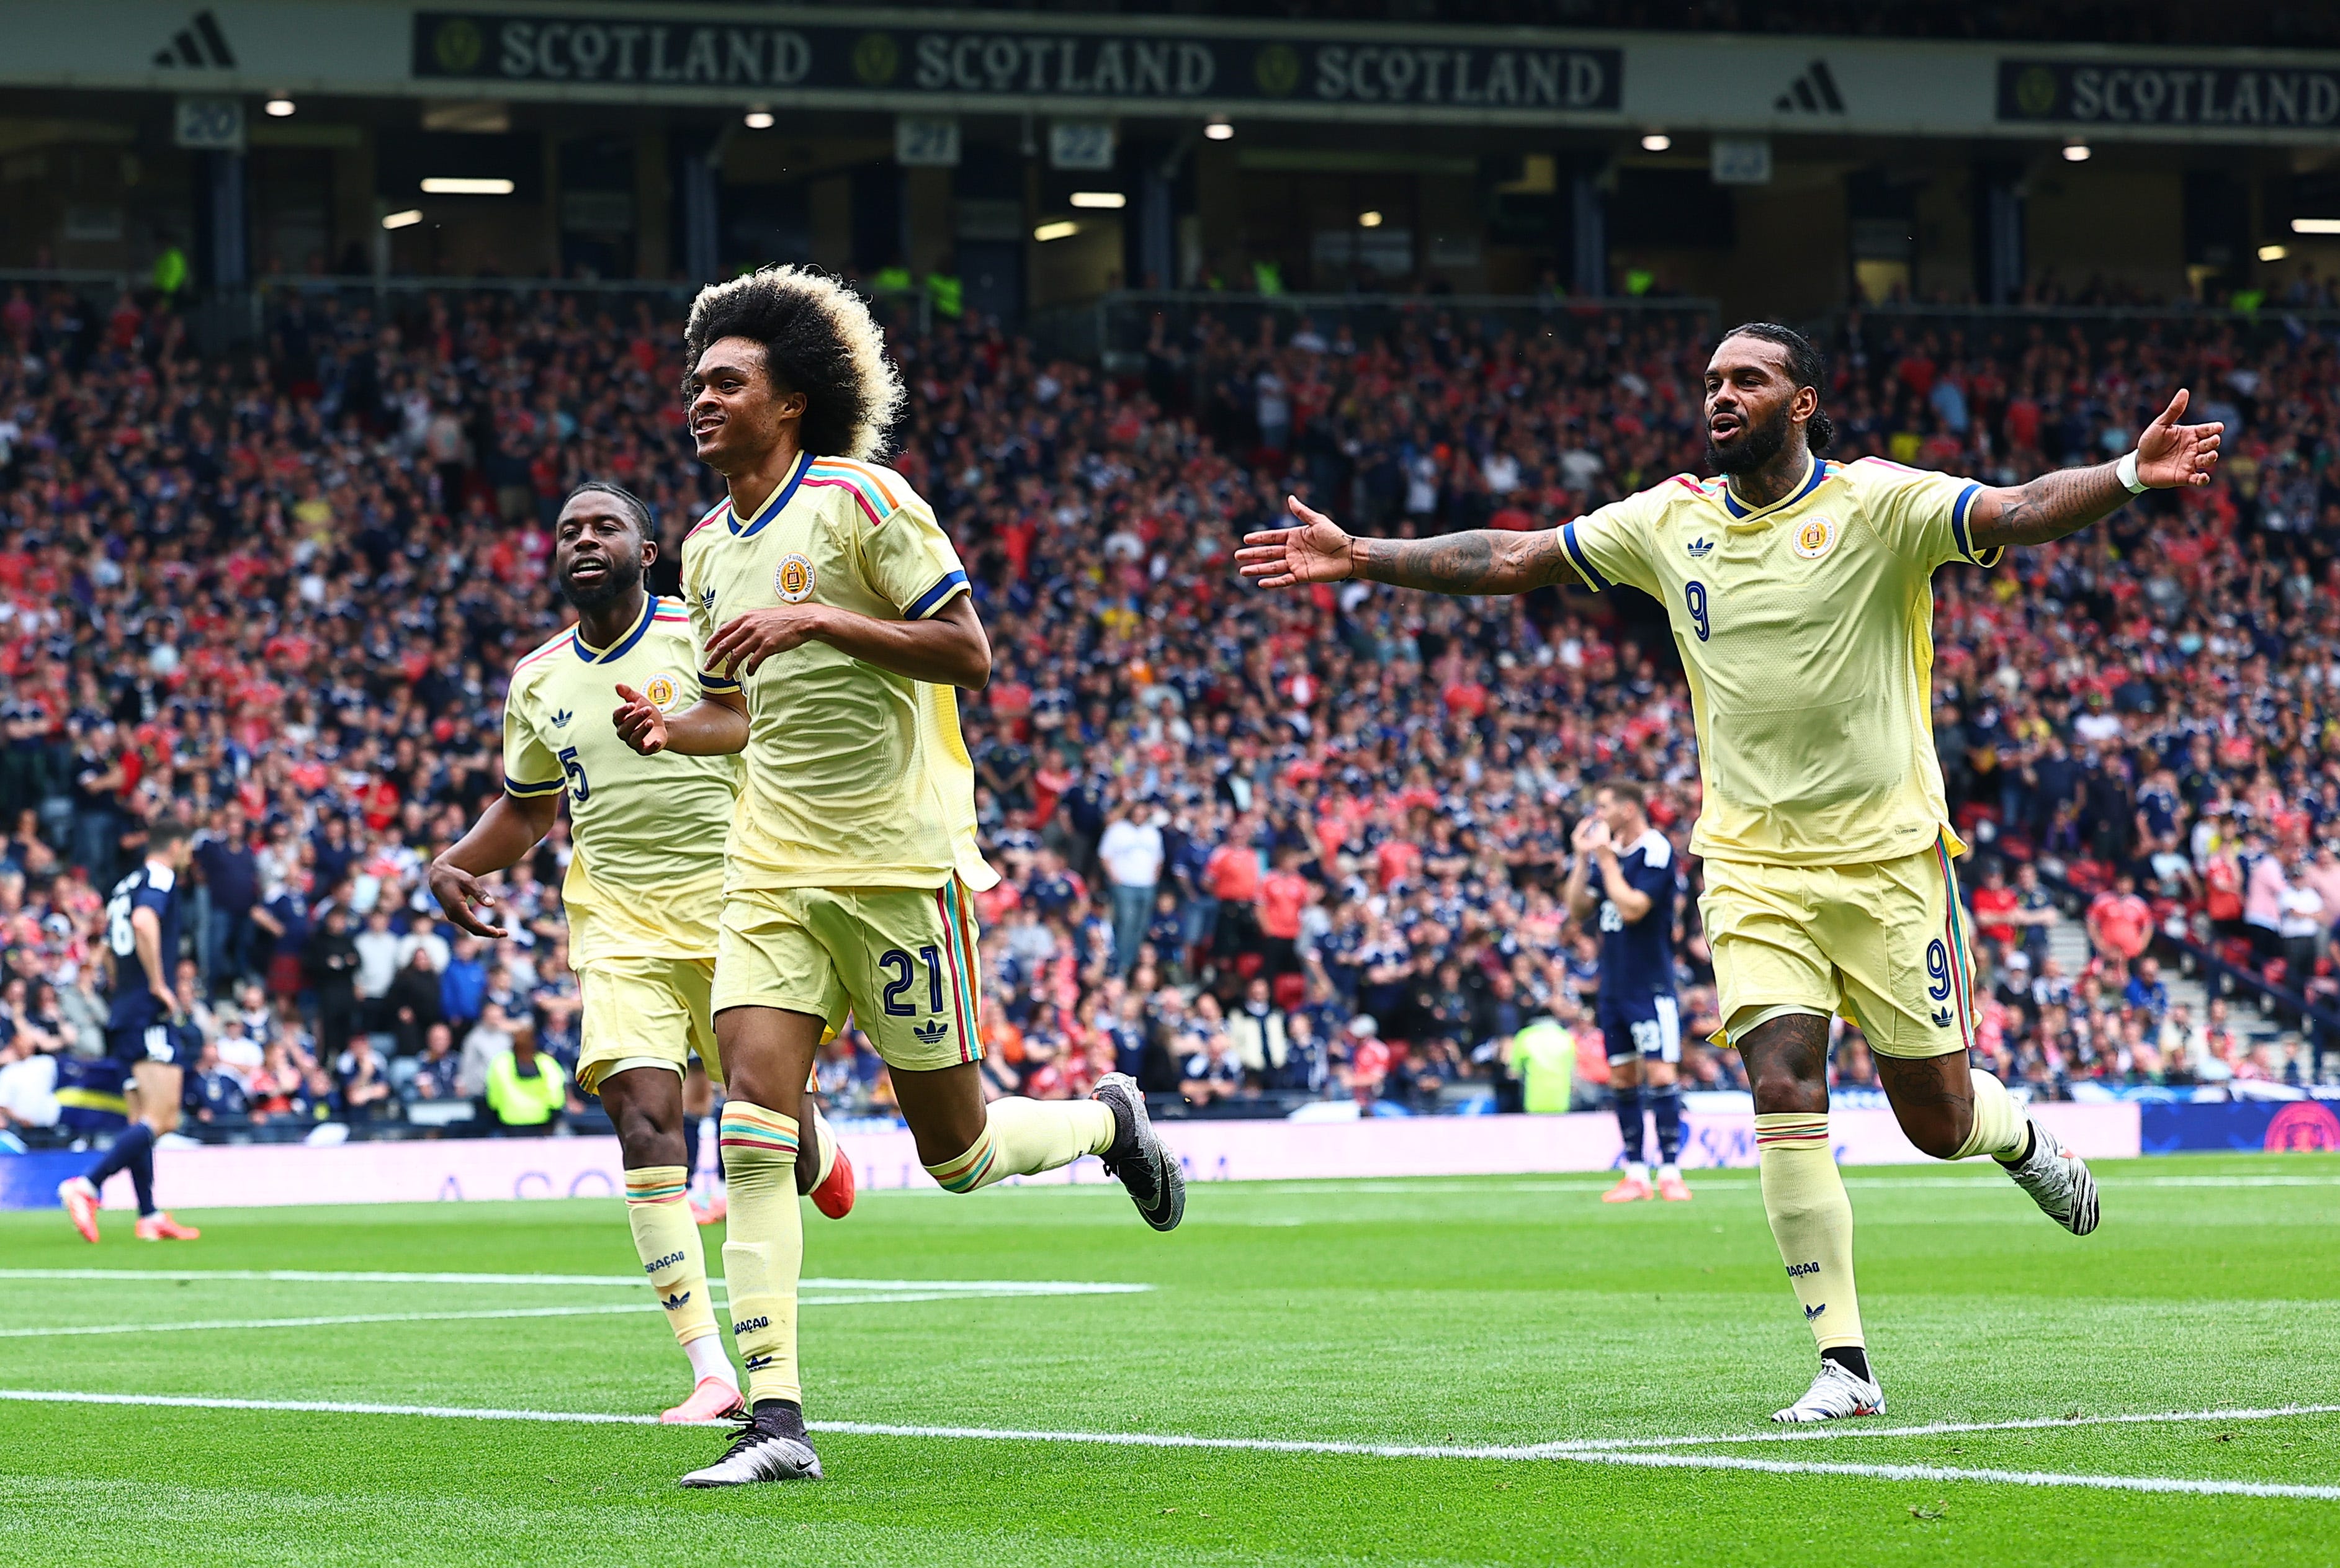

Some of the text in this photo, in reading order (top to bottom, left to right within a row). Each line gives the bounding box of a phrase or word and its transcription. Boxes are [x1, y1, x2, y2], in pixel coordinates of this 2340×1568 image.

[499, 24, 812, 83] SCOTLAND
[914, 34, 1216, 95] SCOTLAND
[1314, 46, 1605, 106] SCOTLAND
[186, 102, 237, 139] 20
[2071, 68, 2339, 124] SCOTLAND
[1685, 581, 1710, 642] 9
[558, 746, 589, 801] 5
[879, 945, 943, 1016] 21
[1926, 938, 1951, 1001] 9
